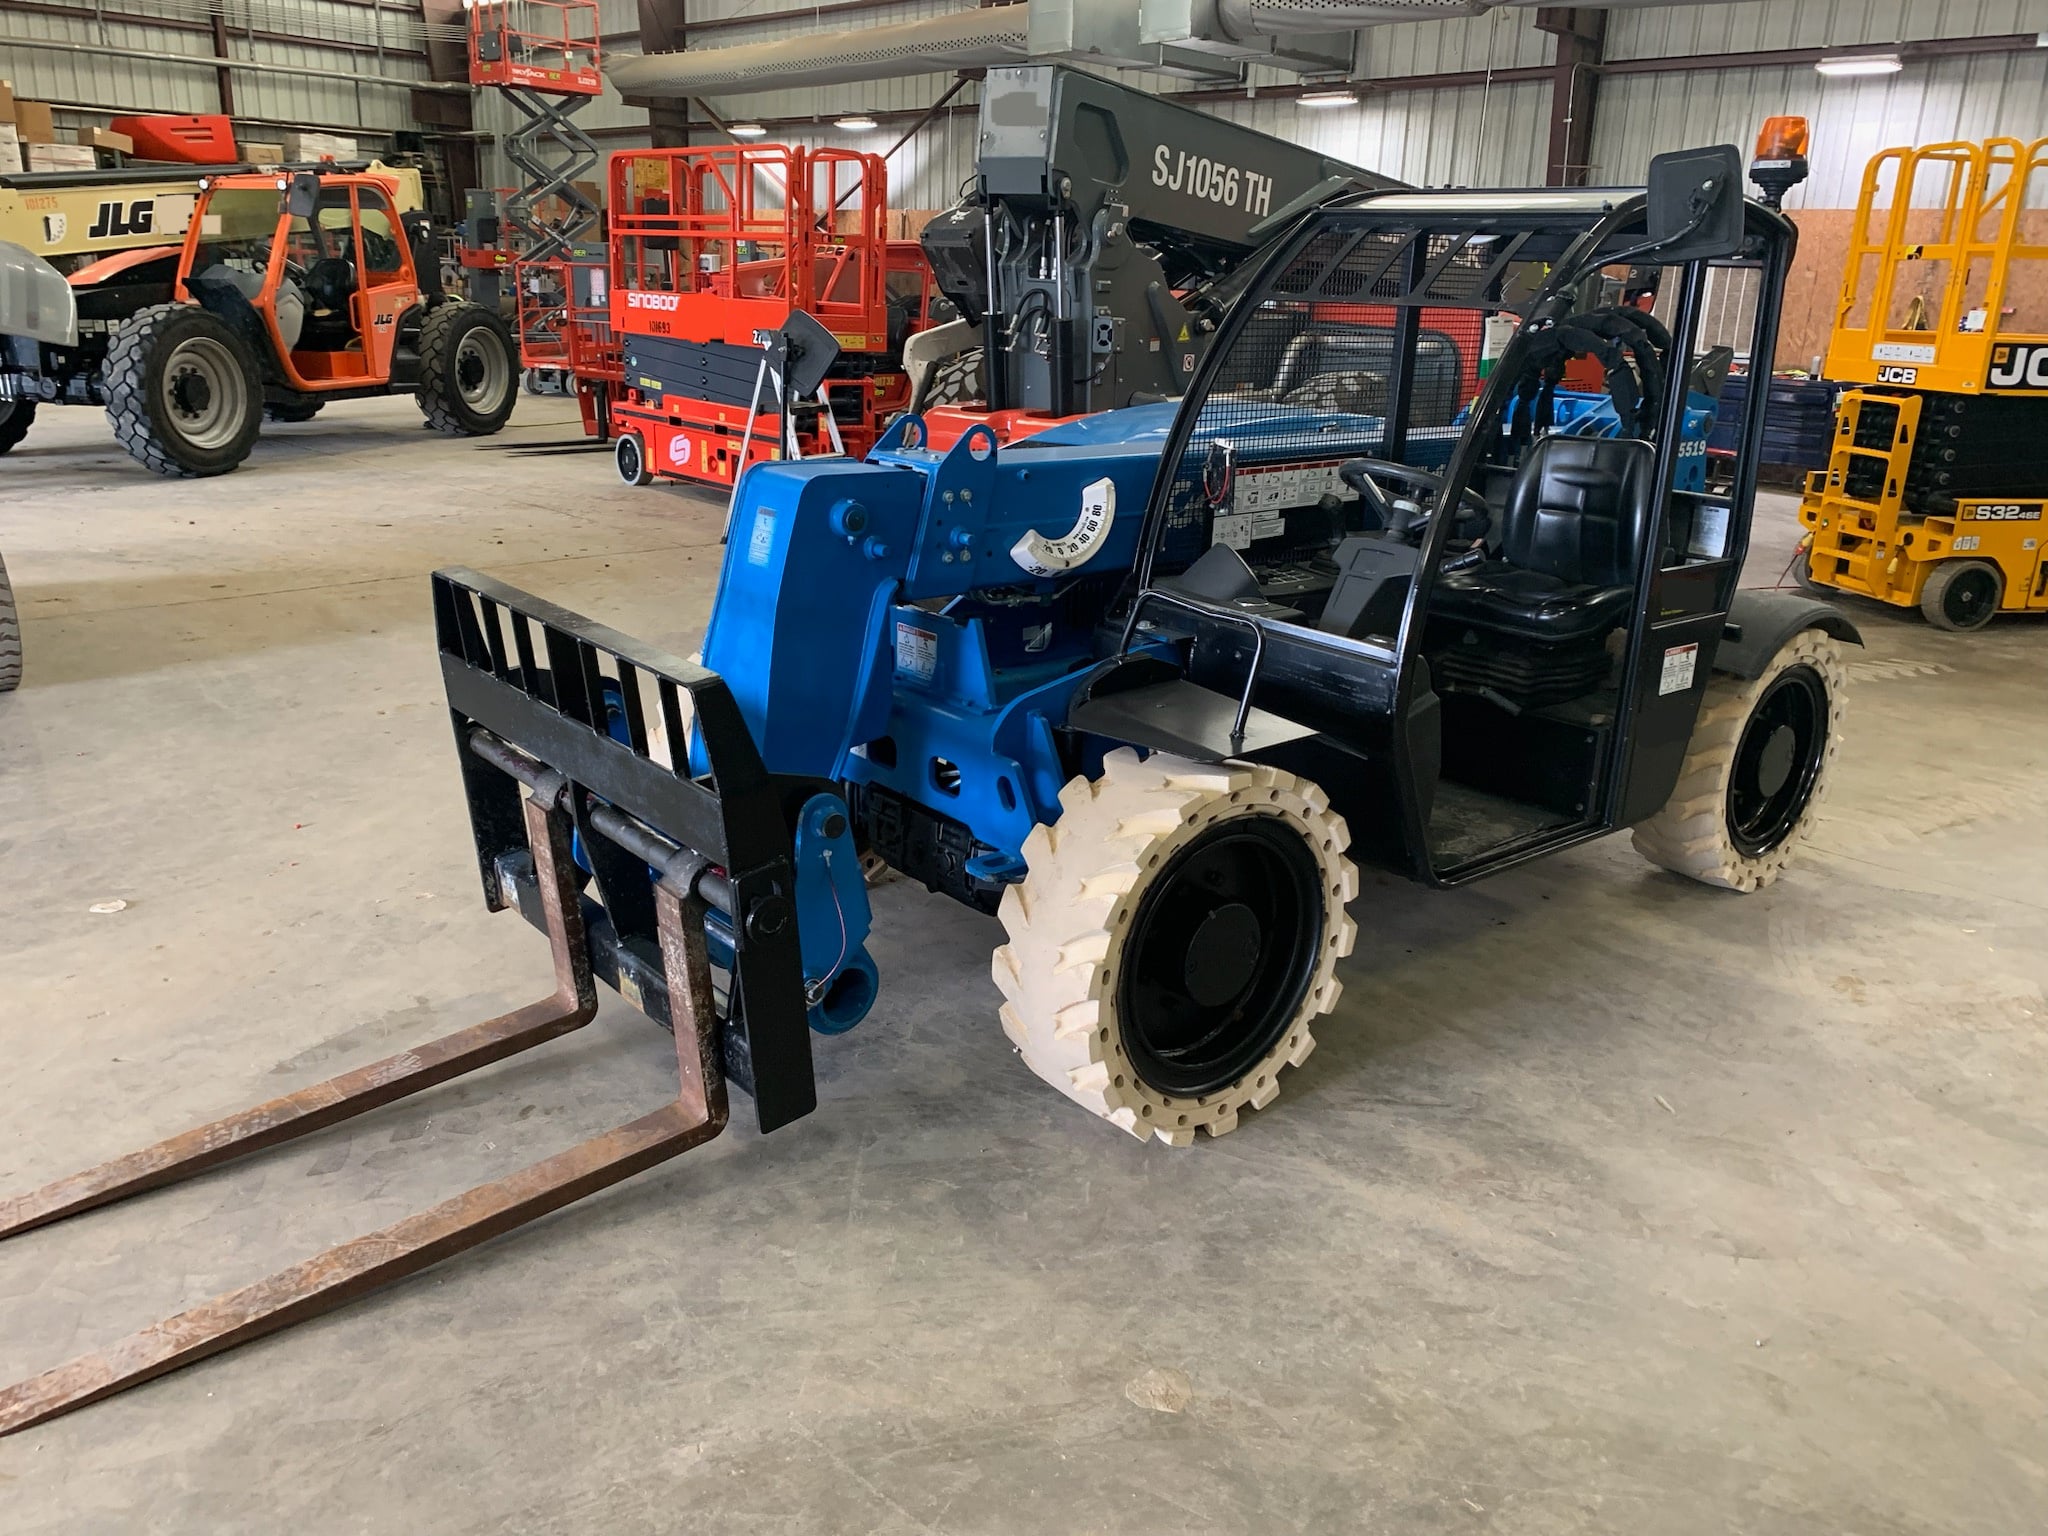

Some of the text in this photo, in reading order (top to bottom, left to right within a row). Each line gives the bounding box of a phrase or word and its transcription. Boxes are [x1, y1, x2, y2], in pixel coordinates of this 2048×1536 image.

[1152, 144, 1273, 217] SJ1056 TH
[88, 200, 154, 238] JLG
[374, 314, 393, 325] JLG
[1877, 366, 1917, 385] JCB
[1990, 347, 2048, 386] JC
[1678, 439, 1707, 458] 5519
[1067, 542, 1079, 553] 20
[1078, 533, 1090, 544] 40
[1086, 519, 1098, 532] 60
[1092, 504, 1103, 517] 80
